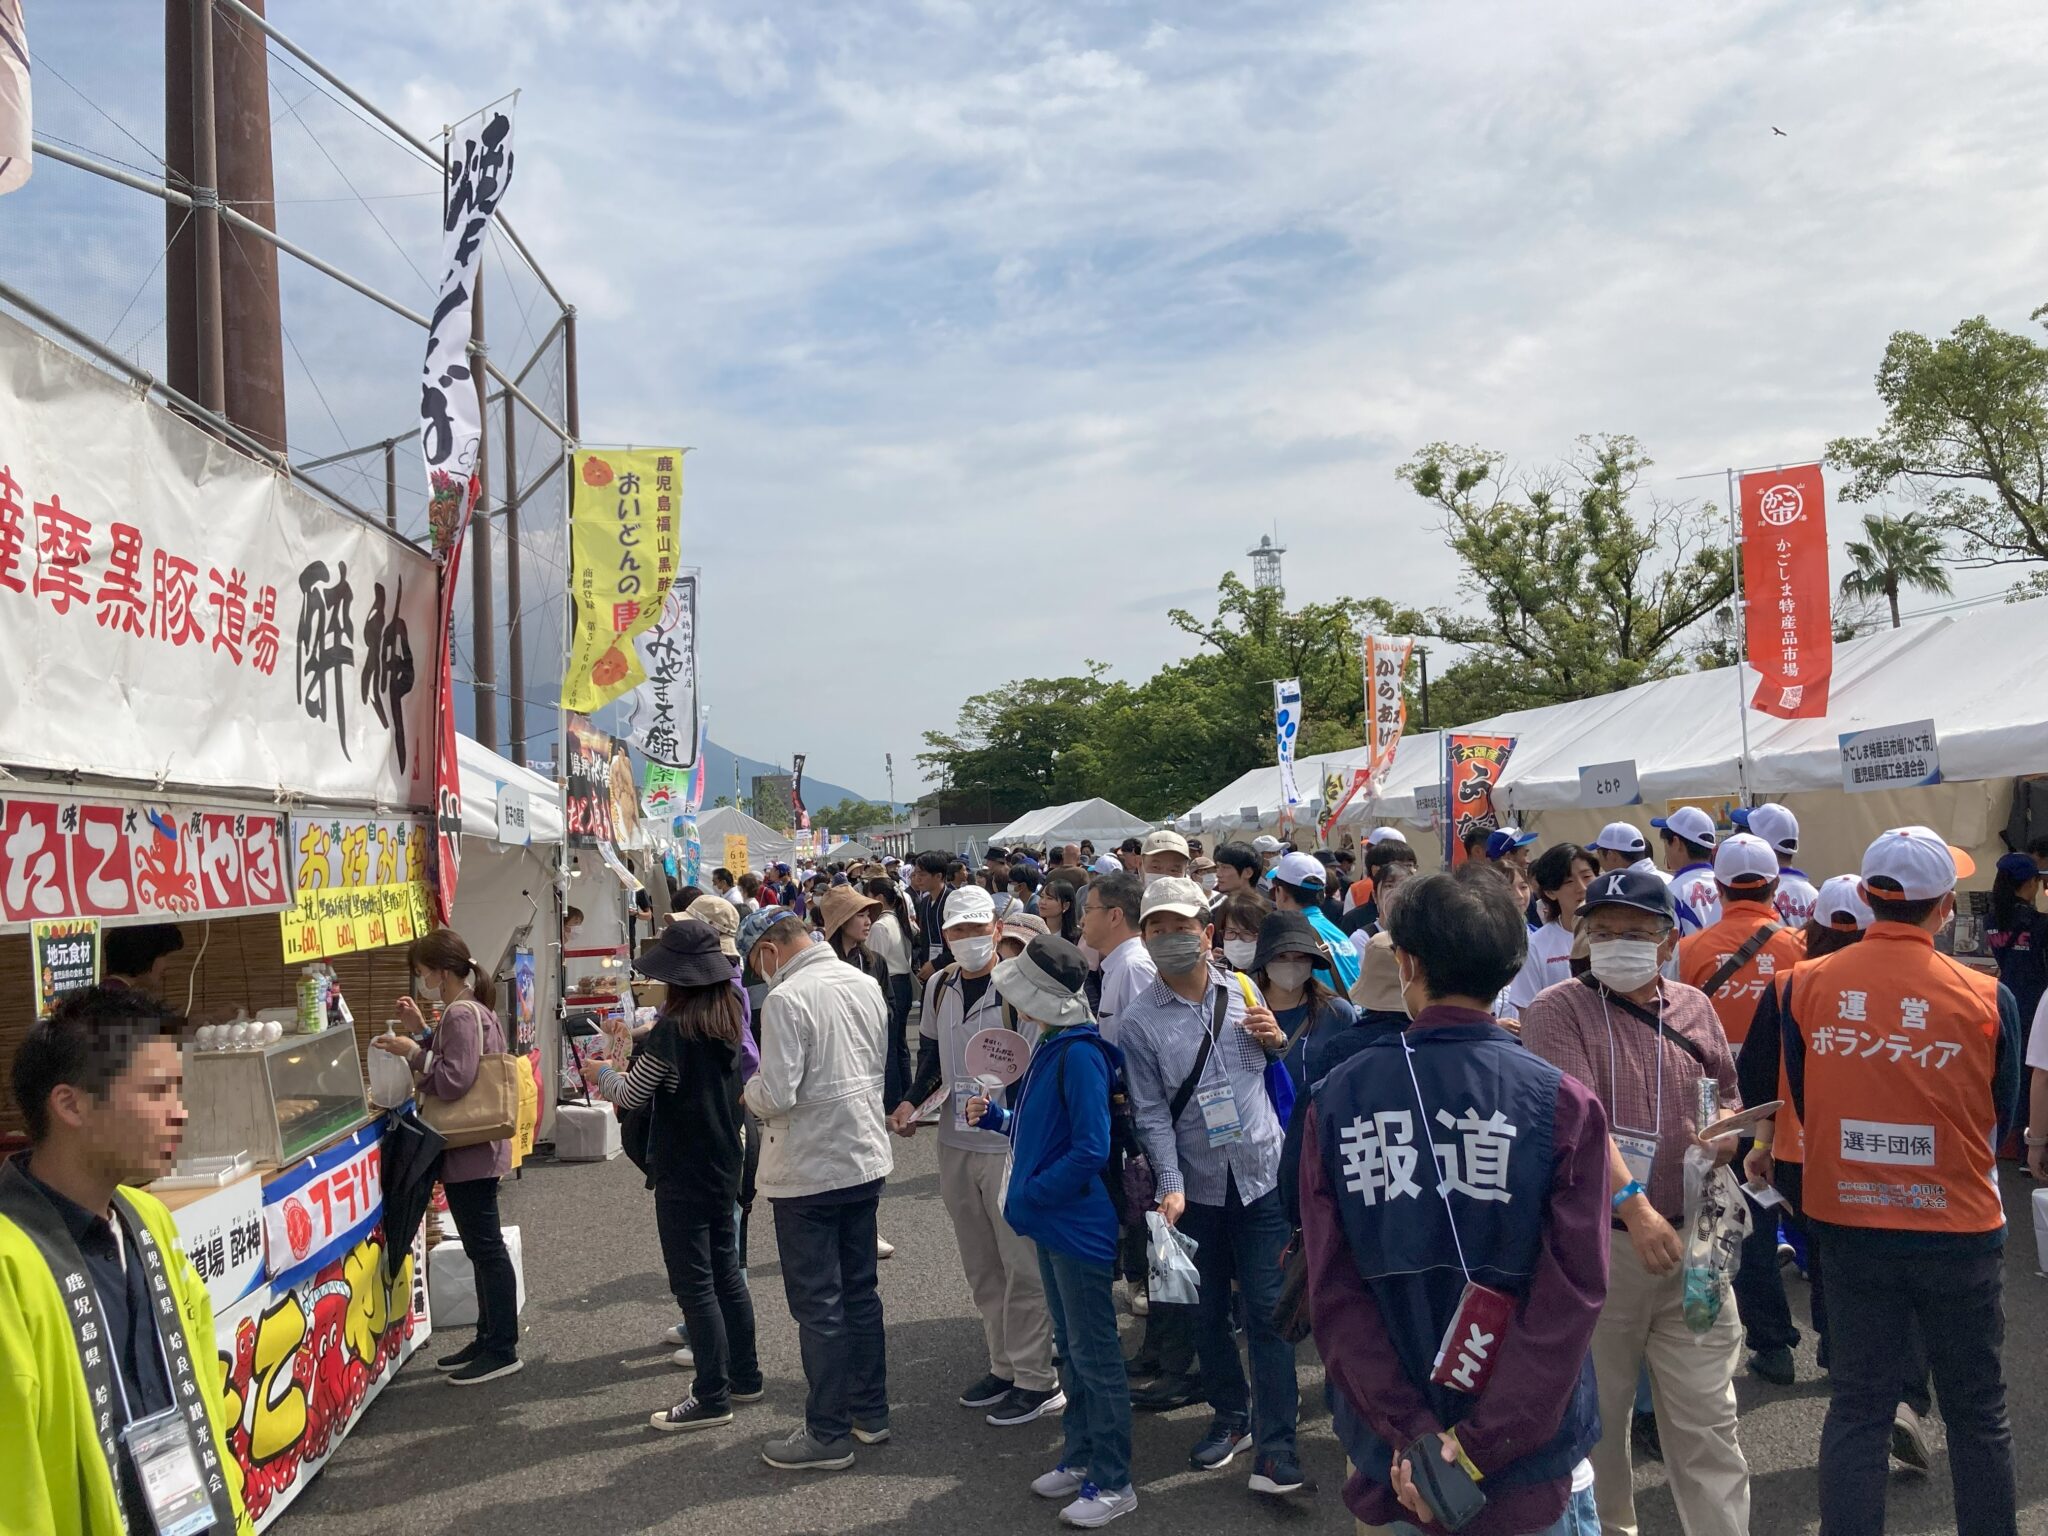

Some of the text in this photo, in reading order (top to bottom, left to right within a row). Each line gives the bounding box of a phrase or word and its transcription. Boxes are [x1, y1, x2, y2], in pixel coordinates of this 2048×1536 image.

[1776, 538, 1799, 678] かごしま特産品市場
[1375, 657, 1395, 747] からあげ
[1843, 734, 1934, 762] かごしま特産品市場「かご市」
[1596, 777, 1620, 795] とわや
[1851, 759, 1927, 784] (鹿児島県商工会連合会)
[1605, 874, 1627, 896] K
[962, 910, 990, 922] ROXY
[46, 941, 91, 966] 地元食材
[1811, 1026, 1963, 1070] ボランティア
[1340, 1107, 1517, 1206] 報道
[1843, 1130, 1932, 1156] 選手団係
[140, 1228, 174, 1314] 鹿児島県
[65, 1271, 101, 1369] 鹿児島県
[1444, 1323, 1494, 1392] HK
